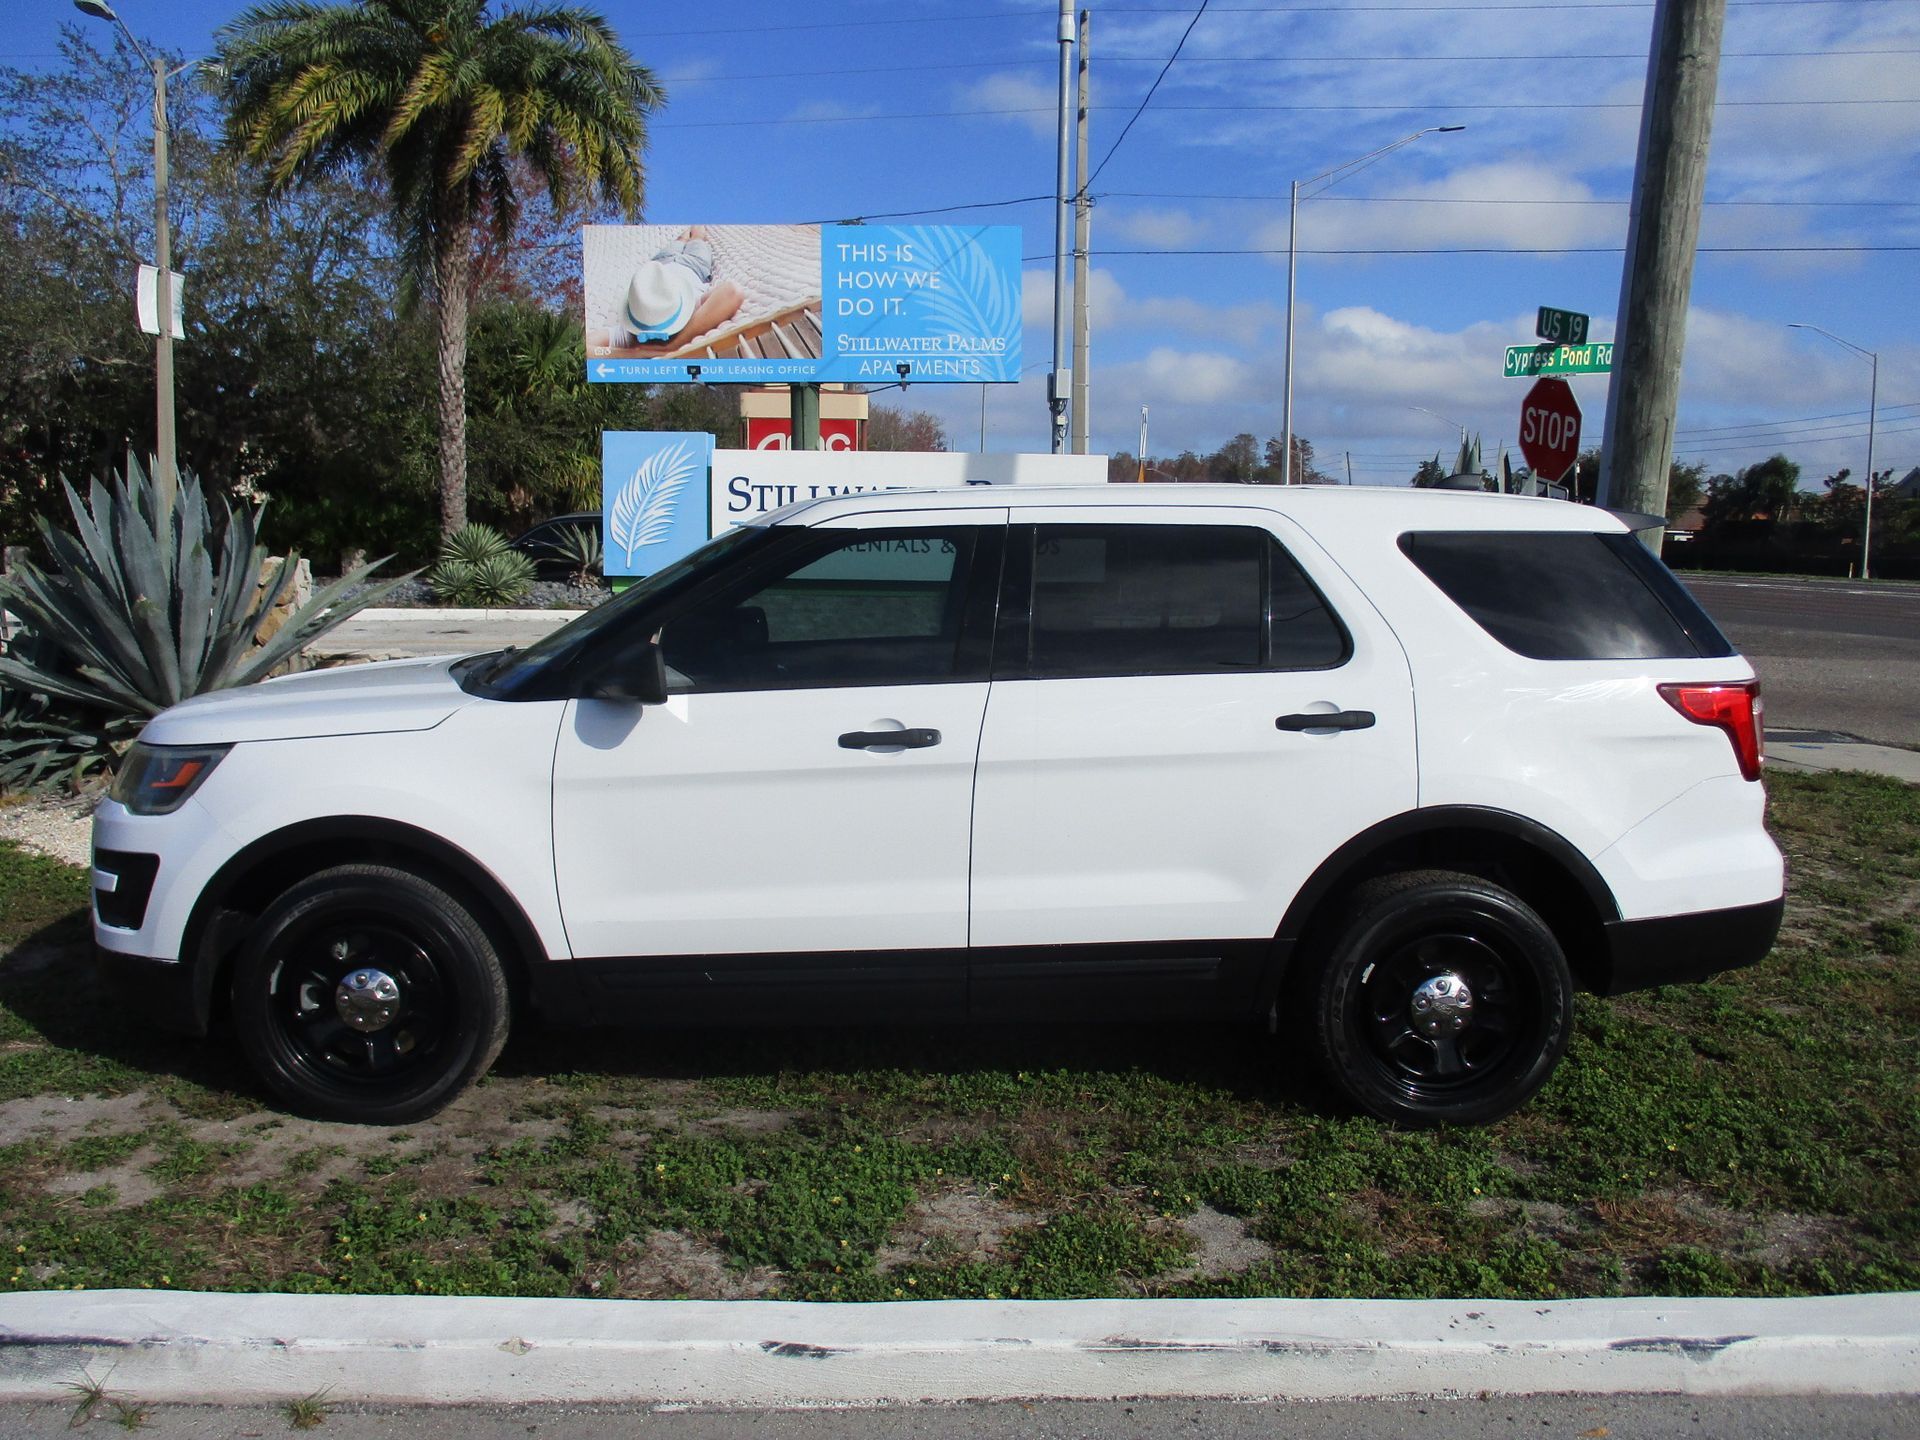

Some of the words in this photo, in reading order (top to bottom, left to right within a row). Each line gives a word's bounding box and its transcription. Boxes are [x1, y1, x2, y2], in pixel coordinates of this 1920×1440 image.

[837, 244, 887, 262] THIS
[896, 244, 913, 262] IS
[838, 271, 898, 289] HOW
[903, 271, 940, 289] WE
[838, 298, 874, 316] DO
[884, 298, 907, 316] IT.
[1542, 310, 1562, 338] US
[1568, 316, 1583, 341] 19
[837, 334, 940, 351] STILLWATER
[948, 334, 1006, 351] PALMS
[1506, 348, 1555, 374] Cypress
[1560, 346, 1591, 366] Pond
[1596, 345, 1613, 365] Rd
[620, 366, 649, 375] TURN
[654, 366, 677, 375] LEFT
[701, 366, 724, 374] OUR
[729, 366, 774, 375] LEASING
[778, 366, 816, 375] OFFICE
[1524, 406, 1576, 452] STOP
[941, 539, 955, 553] &
